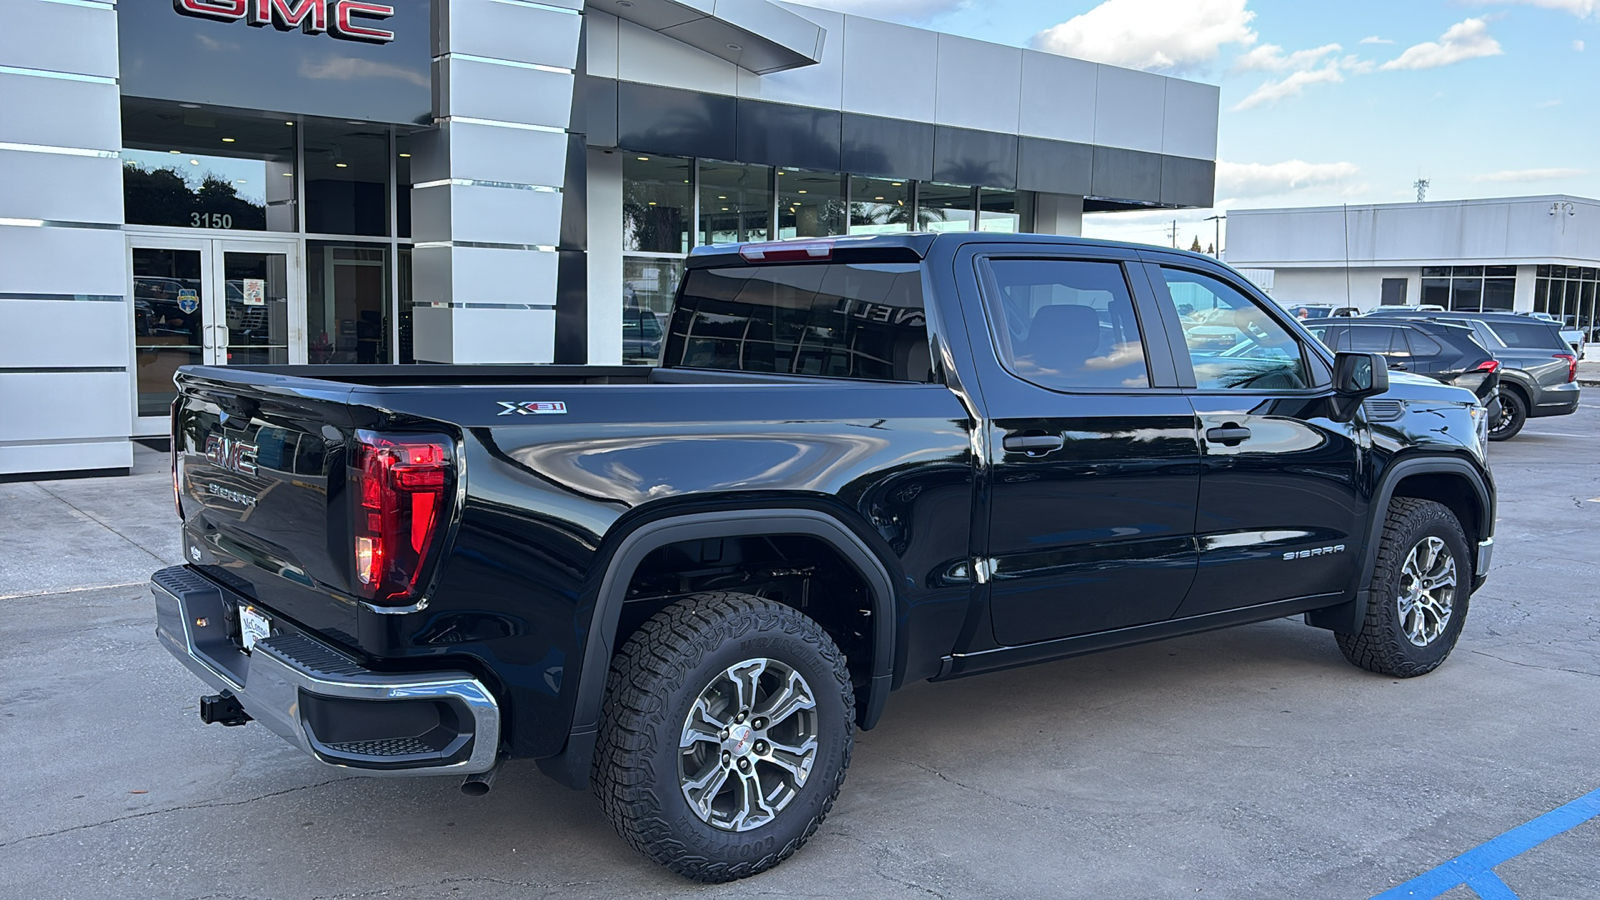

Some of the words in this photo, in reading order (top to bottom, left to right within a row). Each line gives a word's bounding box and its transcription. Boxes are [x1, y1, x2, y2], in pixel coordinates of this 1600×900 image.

[190, 212, 232, 229] 3150
[206, 433, 258, 477] GMC
[208, 483, 258, 507] SIERRA
[1283, 544, 1345, 560] SIERRA
